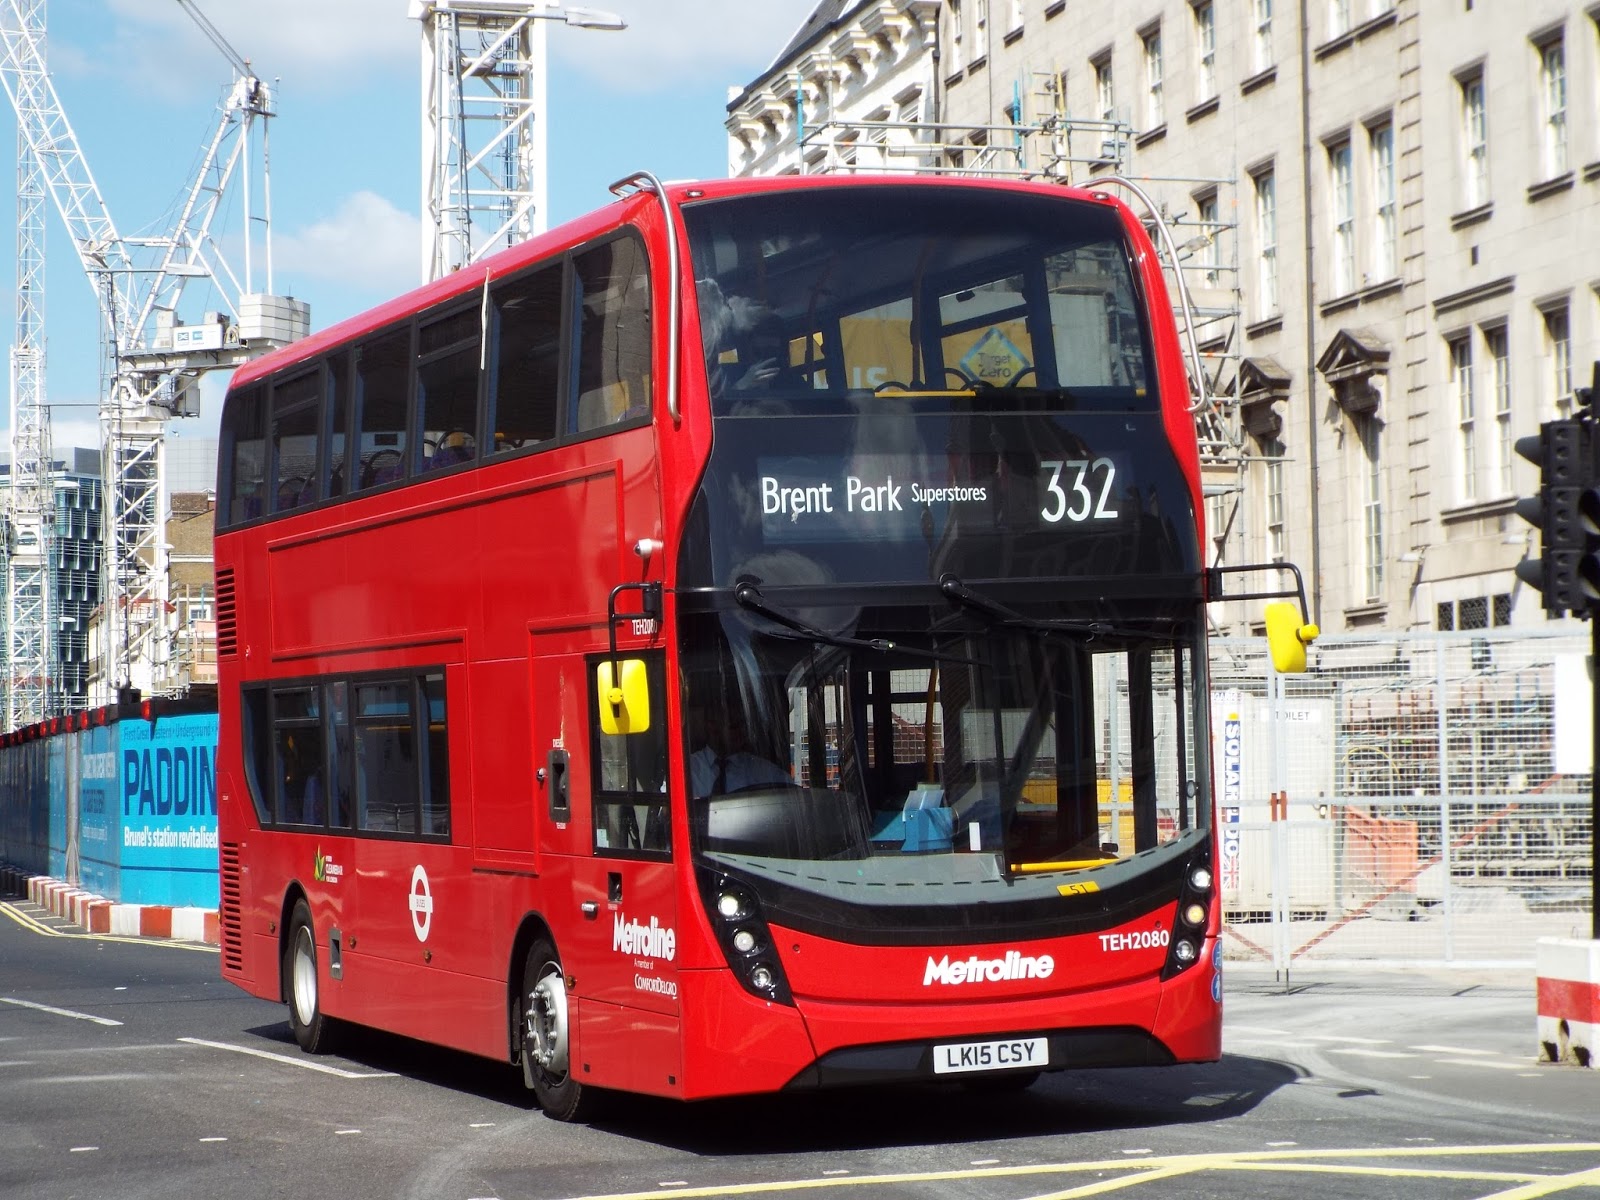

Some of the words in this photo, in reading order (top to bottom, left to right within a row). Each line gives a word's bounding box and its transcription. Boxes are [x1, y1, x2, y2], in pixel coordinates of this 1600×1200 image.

[977, 352, 1012, 366] Trget
[761, 476, 833, 514] Brent
[846, 475, 903, 512] Park
[911, 483, 987, 507] Superstores
[1040, 457, 1119, 523] 332
[1225, 722, 1240, 801] SOLAR
[124, 745, 218, 816] PADDIN
[124, 825, 152, 847] Brunel's
[153, 825, 178, 847] station
[178, 825, 218, 849] revitalised
[1069, 884, 1089, 895] 51
[613, 911, 676, 962] Metroline
[1098, 929, 1170, 951] TEH2080
[923, 950, 1055, 986] Metroline
[946, 1045, 992, 1068] LK15
[998, 1041, 1036, 1064] CSY
